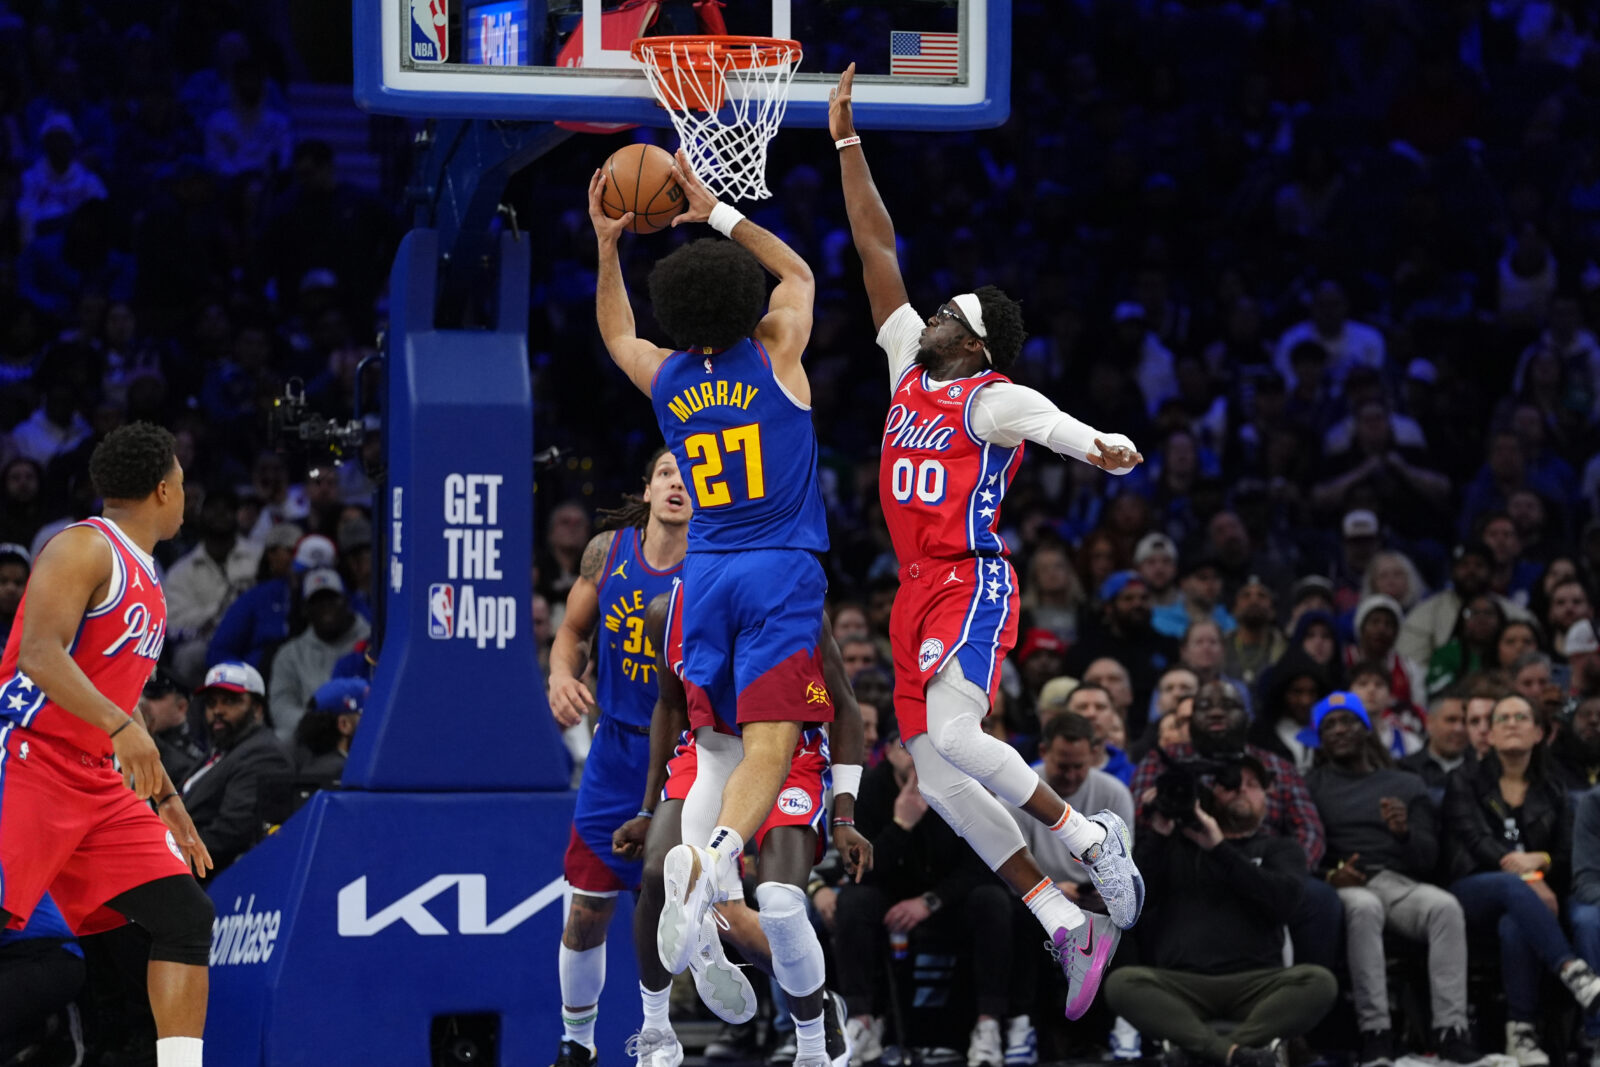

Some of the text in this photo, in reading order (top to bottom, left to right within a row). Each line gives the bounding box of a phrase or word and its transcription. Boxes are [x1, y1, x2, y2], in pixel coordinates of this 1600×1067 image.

[414, 42, 434, 57] NBA
[667, 380, 759, 423] MURRAY
[881, 403, 958, 452] Phila
[684, 421, 765, 508] 27
[892, 457, 948, 506] 00
[444, 473, 503, 525] GET
[443, 528, 503, 580] THE
[456, 585, 516, 649] App
[605, 590, 644, 633] MILE
